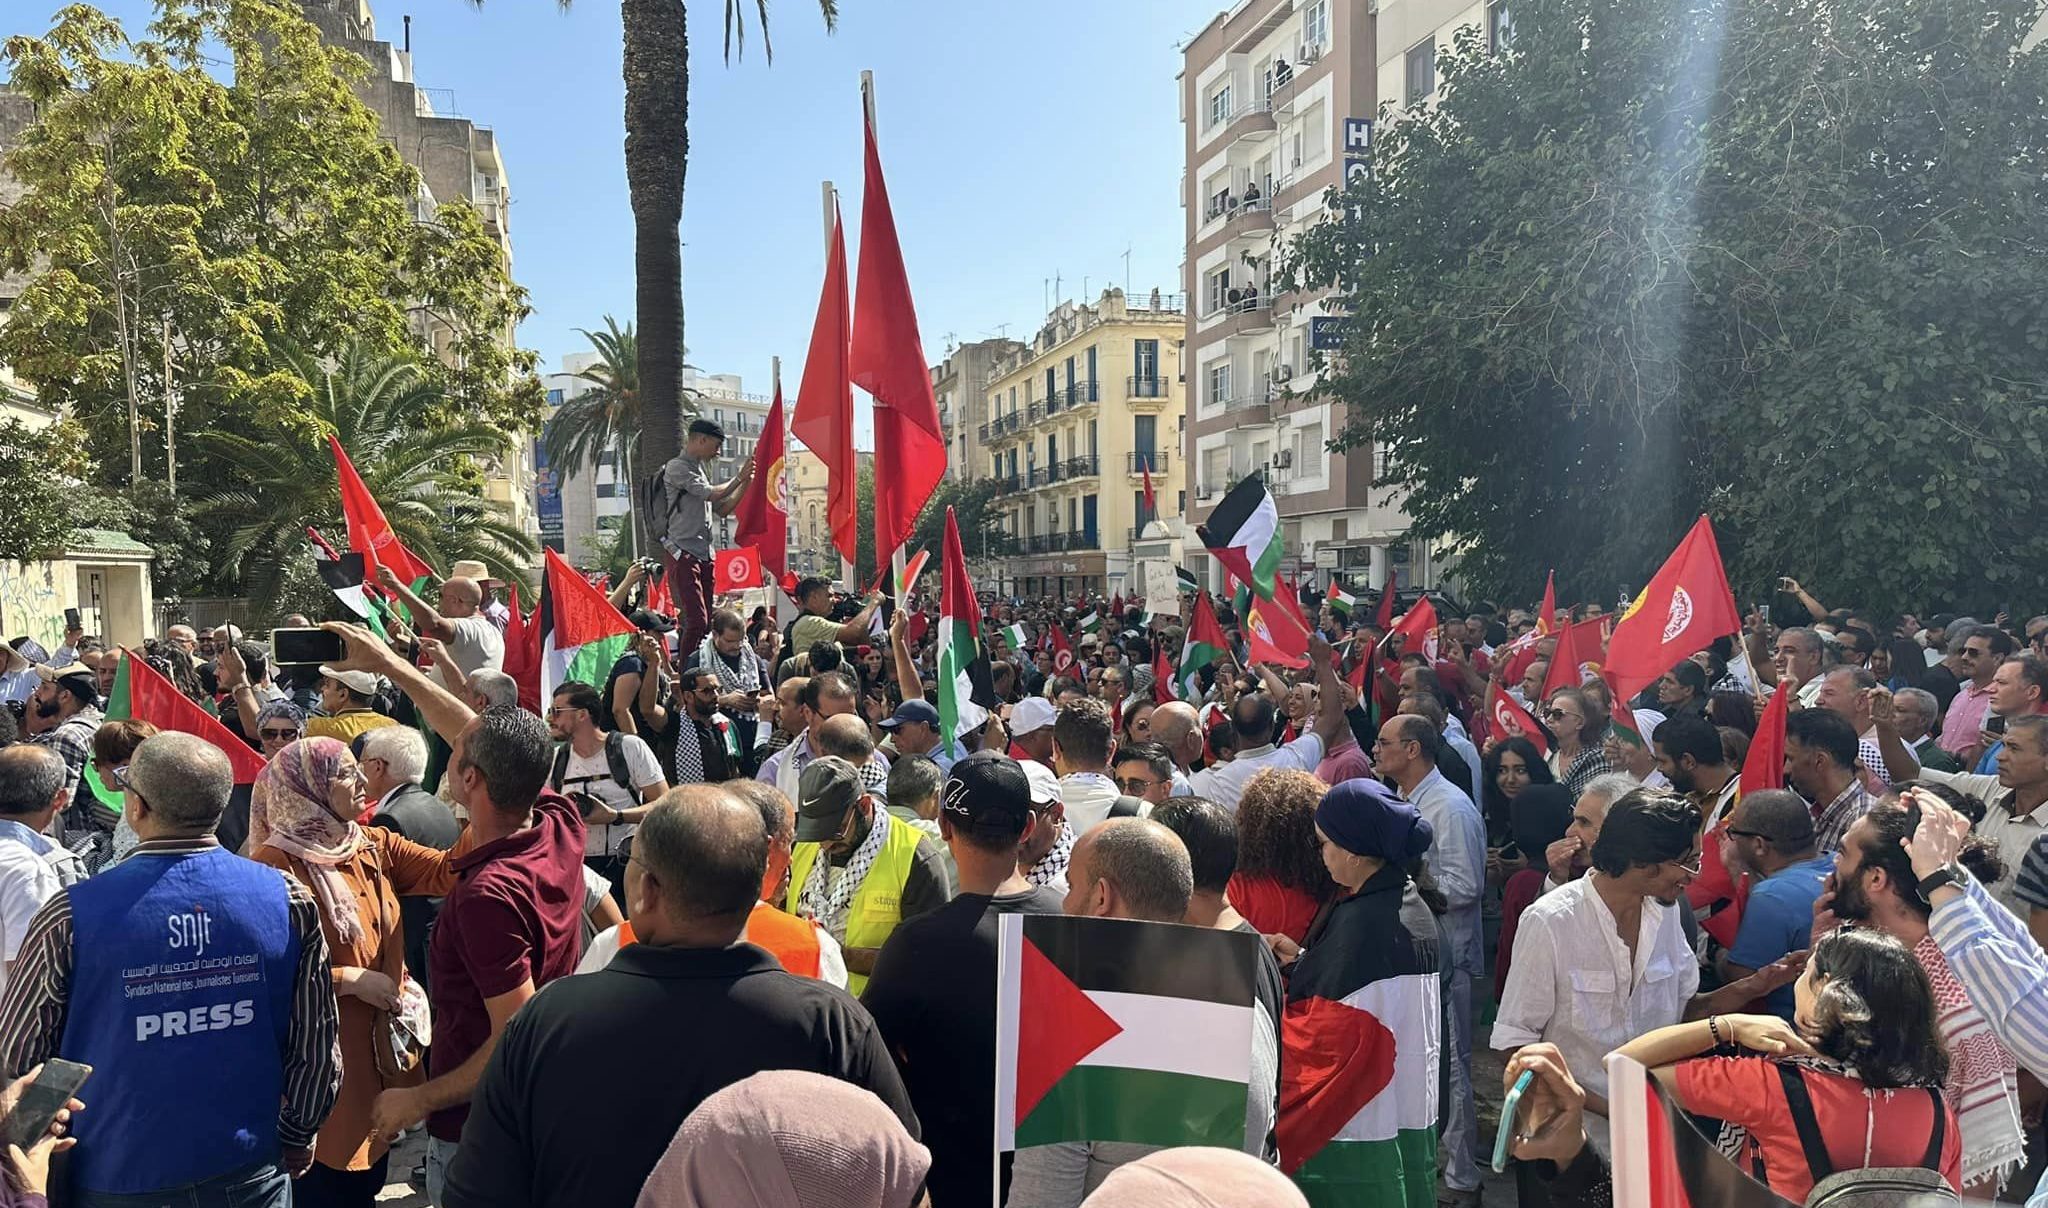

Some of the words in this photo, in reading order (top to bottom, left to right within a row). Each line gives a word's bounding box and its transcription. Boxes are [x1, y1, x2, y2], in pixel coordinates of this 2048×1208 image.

[168, 903, 212, 956] snjt
[124, 983, 154, 999] Syndicat
[154, 981, 182, 996] National
[182, 979, 194, 991] des
[194, 974, 232, 989] Journalistes
[136, 1000, 255, 1042] PRESS
